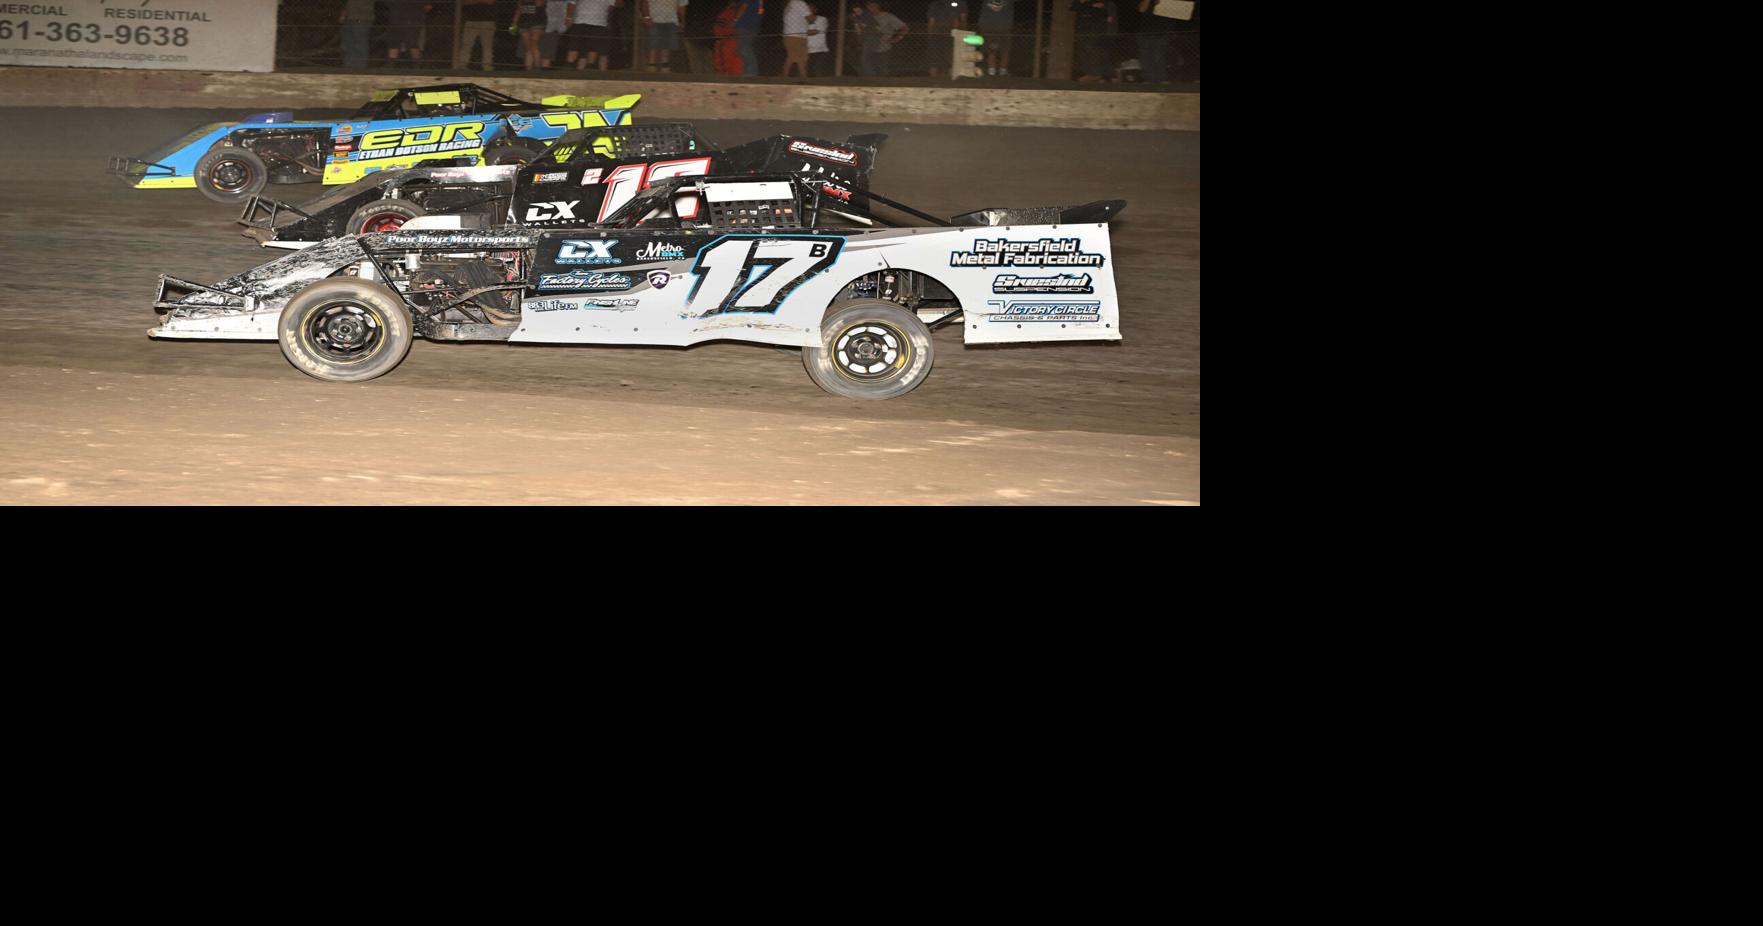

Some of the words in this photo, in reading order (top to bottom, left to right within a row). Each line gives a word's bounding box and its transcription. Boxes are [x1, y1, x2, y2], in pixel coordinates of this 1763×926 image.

[104, 8, 212, 22] RESIDENTIAL
[360, 122, 484, 151] EDR
[359, 148, 394, 160] ETHAN
[395, 143, 437, 156] DOTSON
[440, 139, 482, 152] RACING
[581, 168, 603, 186] 2
[526, 200, 580, 221] CX
[520, 219, 586, 227] WALLETS
[419, 235, 449, 244] Boyz
[450, 235, 530, 244] Motorsports
[974, 239, 1080, 252] Bakersfield
[558, 239, 620, 259] CX
[636, 241, 685, 258] Metro
[951, 252, 999, 266] Metal
[1003, 252, 1101, 266] Fabrication
[541, 274, 587, 288] Factory
[588, 273, 626, 288] Cycles
[688, 235, 847, 318] 17
[809, 243, 828, 258] B
